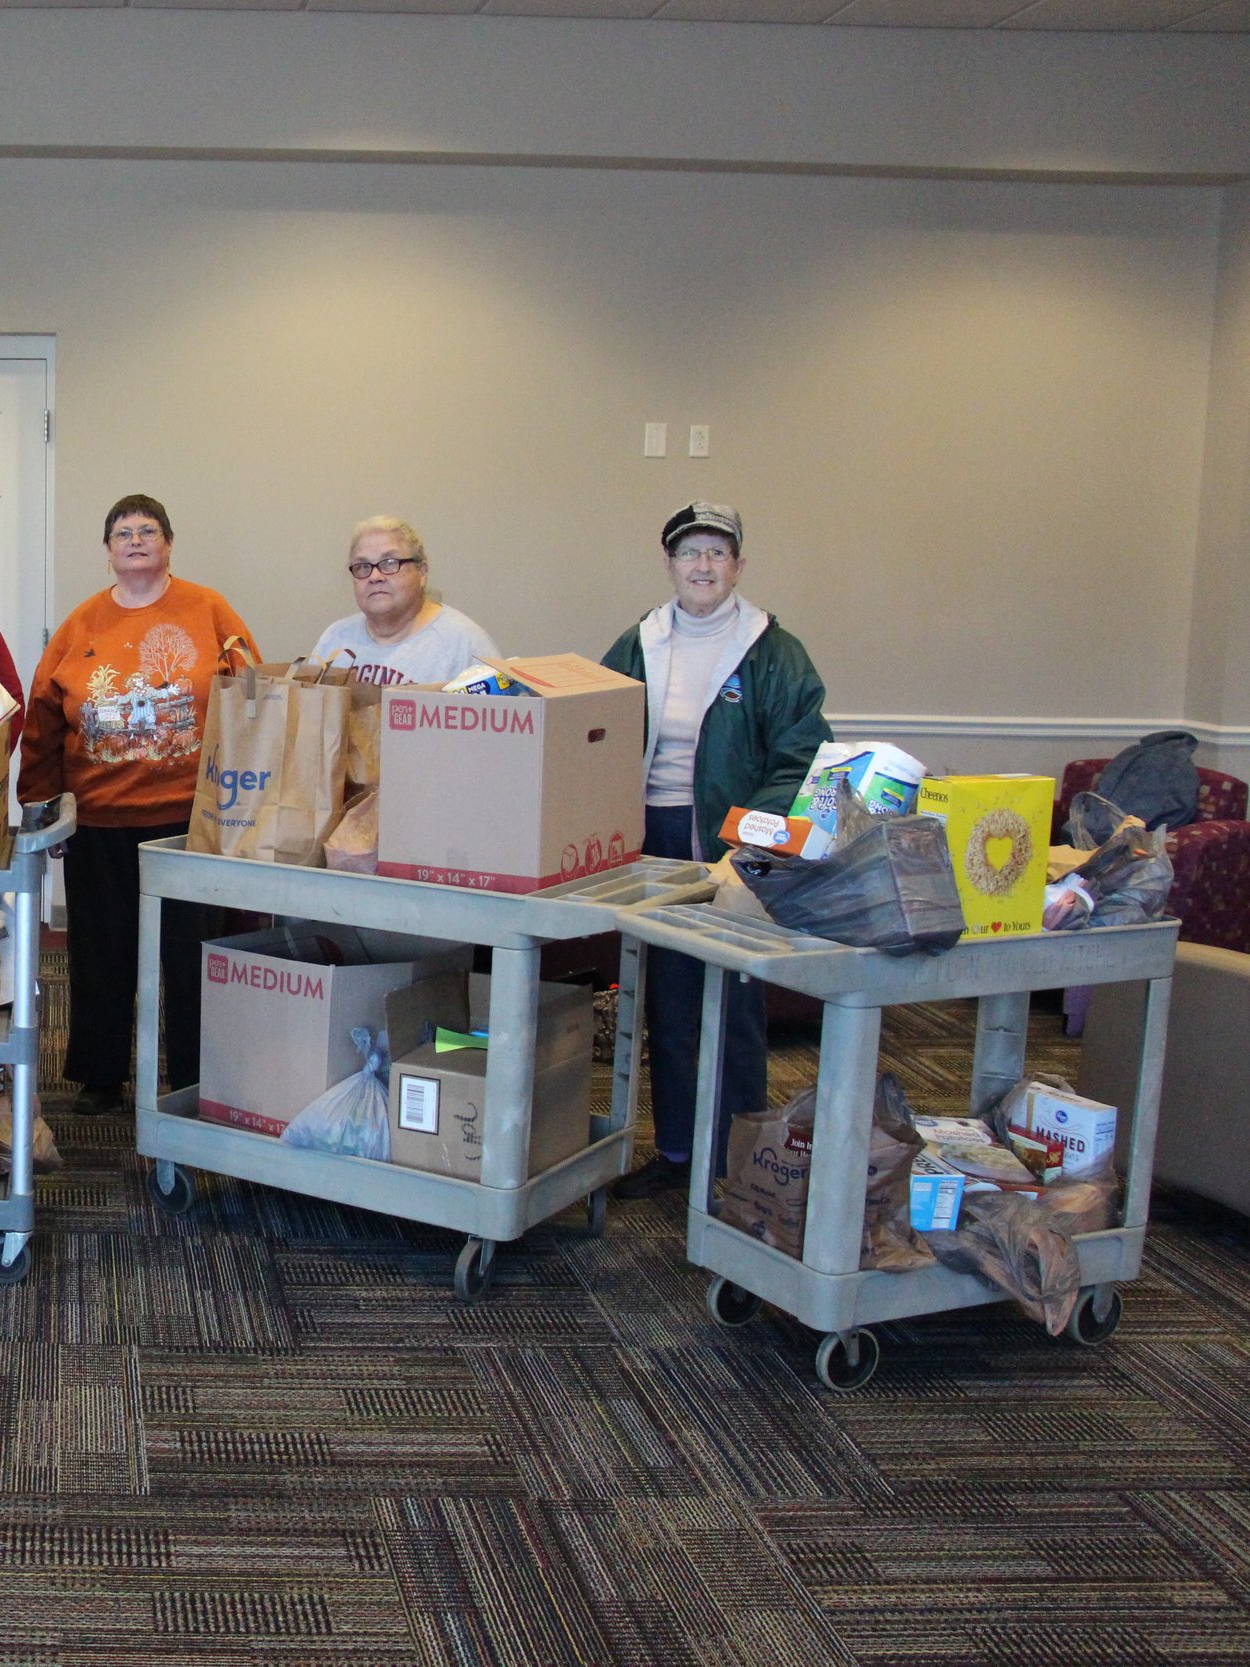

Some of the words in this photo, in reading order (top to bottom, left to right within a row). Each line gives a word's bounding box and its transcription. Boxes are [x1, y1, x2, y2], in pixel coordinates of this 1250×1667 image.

[393, 712, 413, 726] GEAR
[418, 703, 535, 735] MEDIUM
[1012, 920, 1032, 931] Yours
[230, 961, 325, 1001] MEDIUM
[1035, 1125, 1086, 1153] MASHED
[752, 1147, 809, 1187] Kroger
